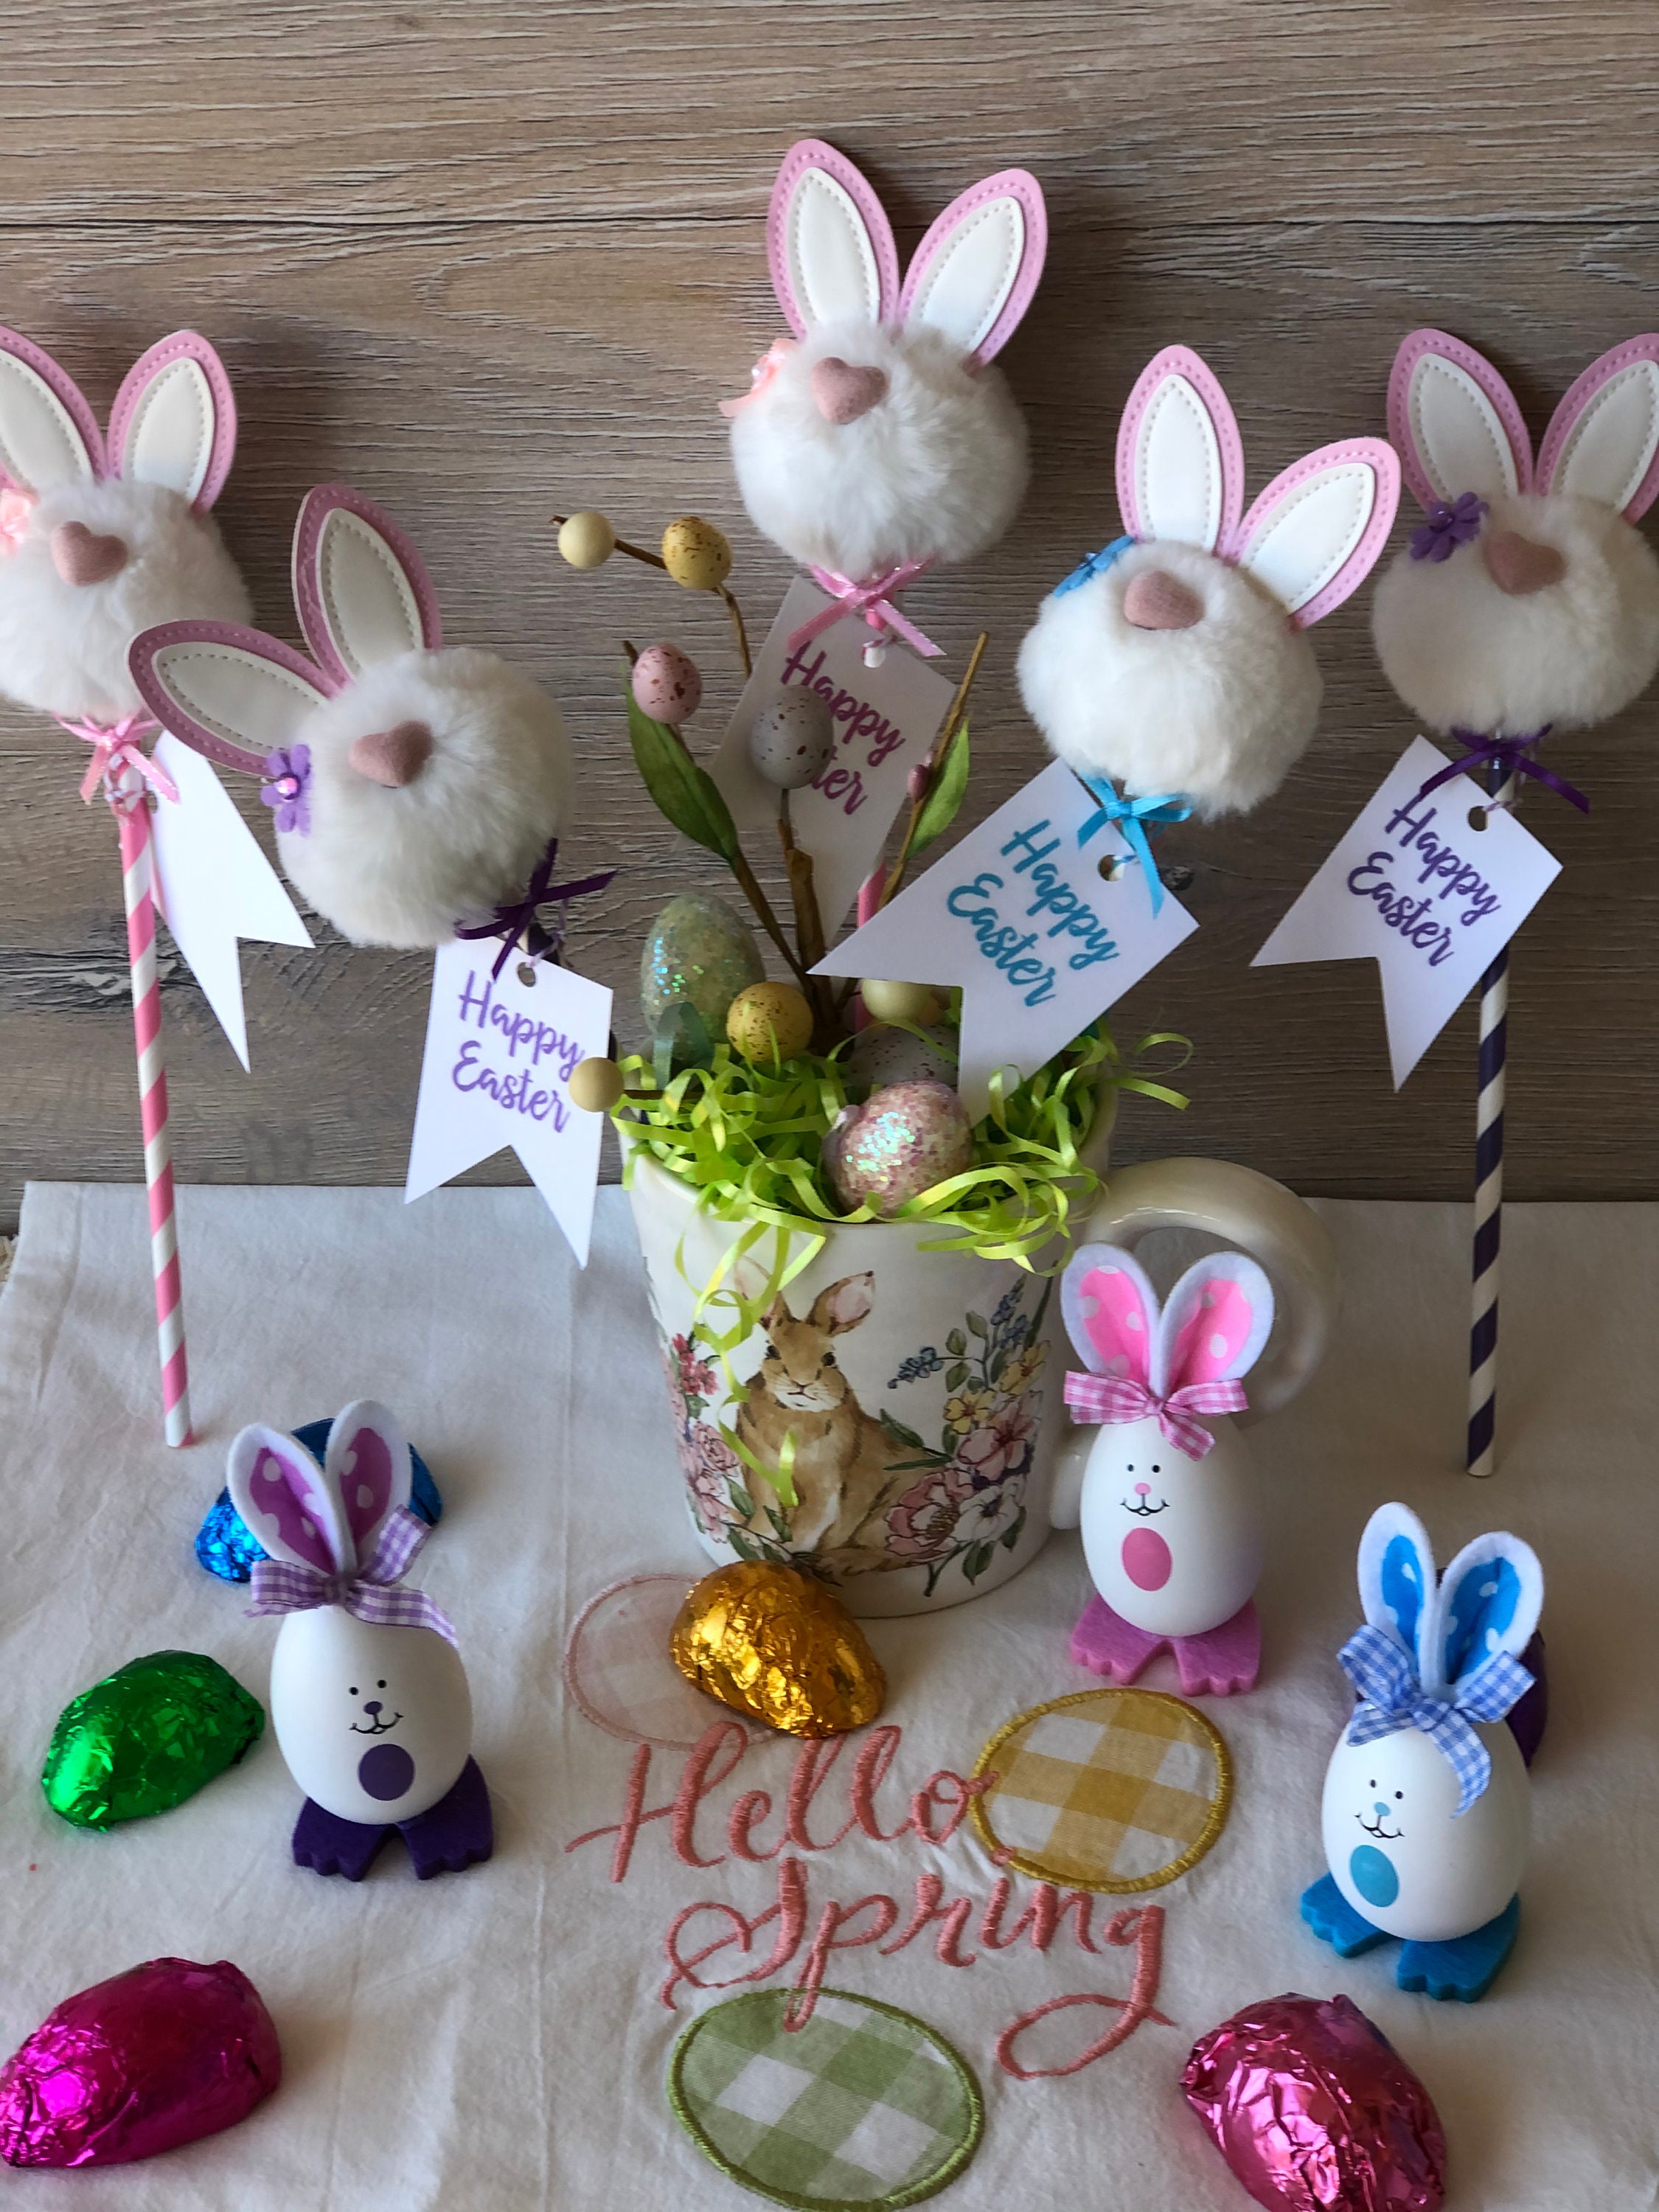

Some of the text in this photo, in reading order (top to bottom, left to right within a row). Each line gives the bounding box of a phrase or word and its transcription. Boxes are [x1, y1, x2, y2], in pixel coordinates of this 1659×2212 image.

[781, 641, 906, 767] Happy
[1000, 818, 1120, 970] Happy
[1347, 851, 1454, 967] Easter
[1385, 793, 1501, 927] Happy
[946, 872, 1057, 1007] Easter
[452, 1040, 571, 1133] Easter
[458, 970, 585, 1082] Happy
[565, 1720, 1001, 1884] Hello
[660, 1857, 1176, 2081] Spring
